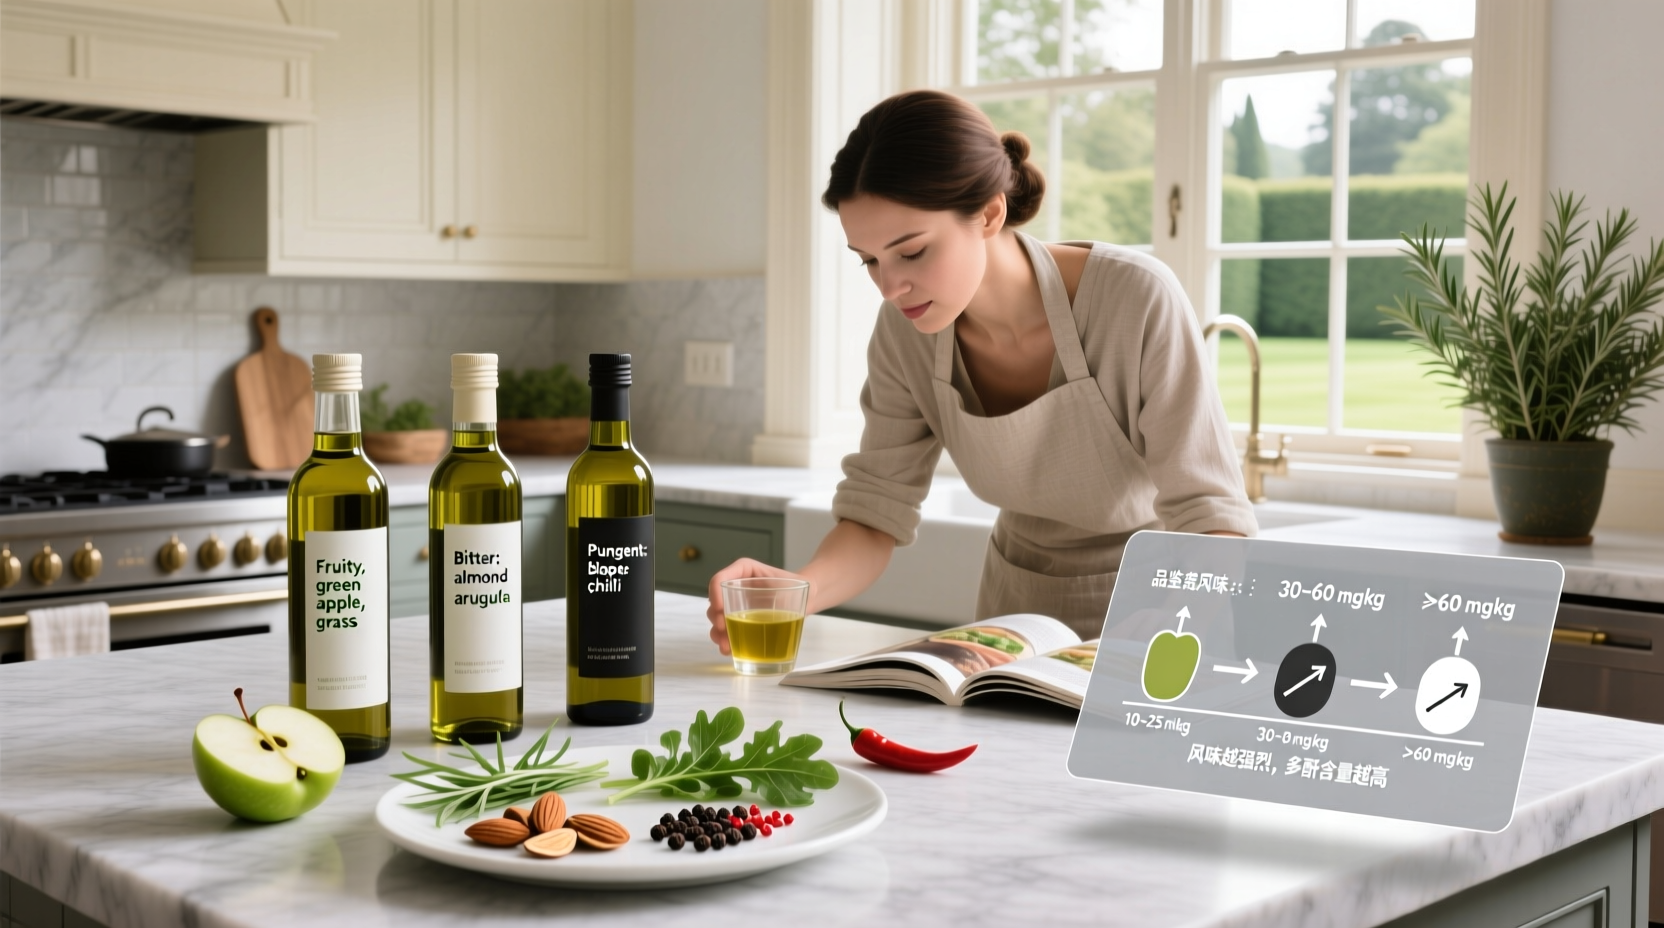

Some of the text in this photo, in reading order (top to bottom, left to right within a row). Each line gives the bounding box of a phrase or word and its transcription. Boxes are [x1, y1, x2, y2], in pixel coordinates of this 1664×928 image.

[454, 549, 500, 565] Bitter:
[588, 543, 648, 561] Pungent:
[316, 558, 365, 577] Fruity,
[454, 567, 508, 584] almond
[316, 580, 361, 596] green
[316, 593, 365, 613] apple,
[454, 589, 511, 609] arugula
[316, 616, 358, 632] grass
